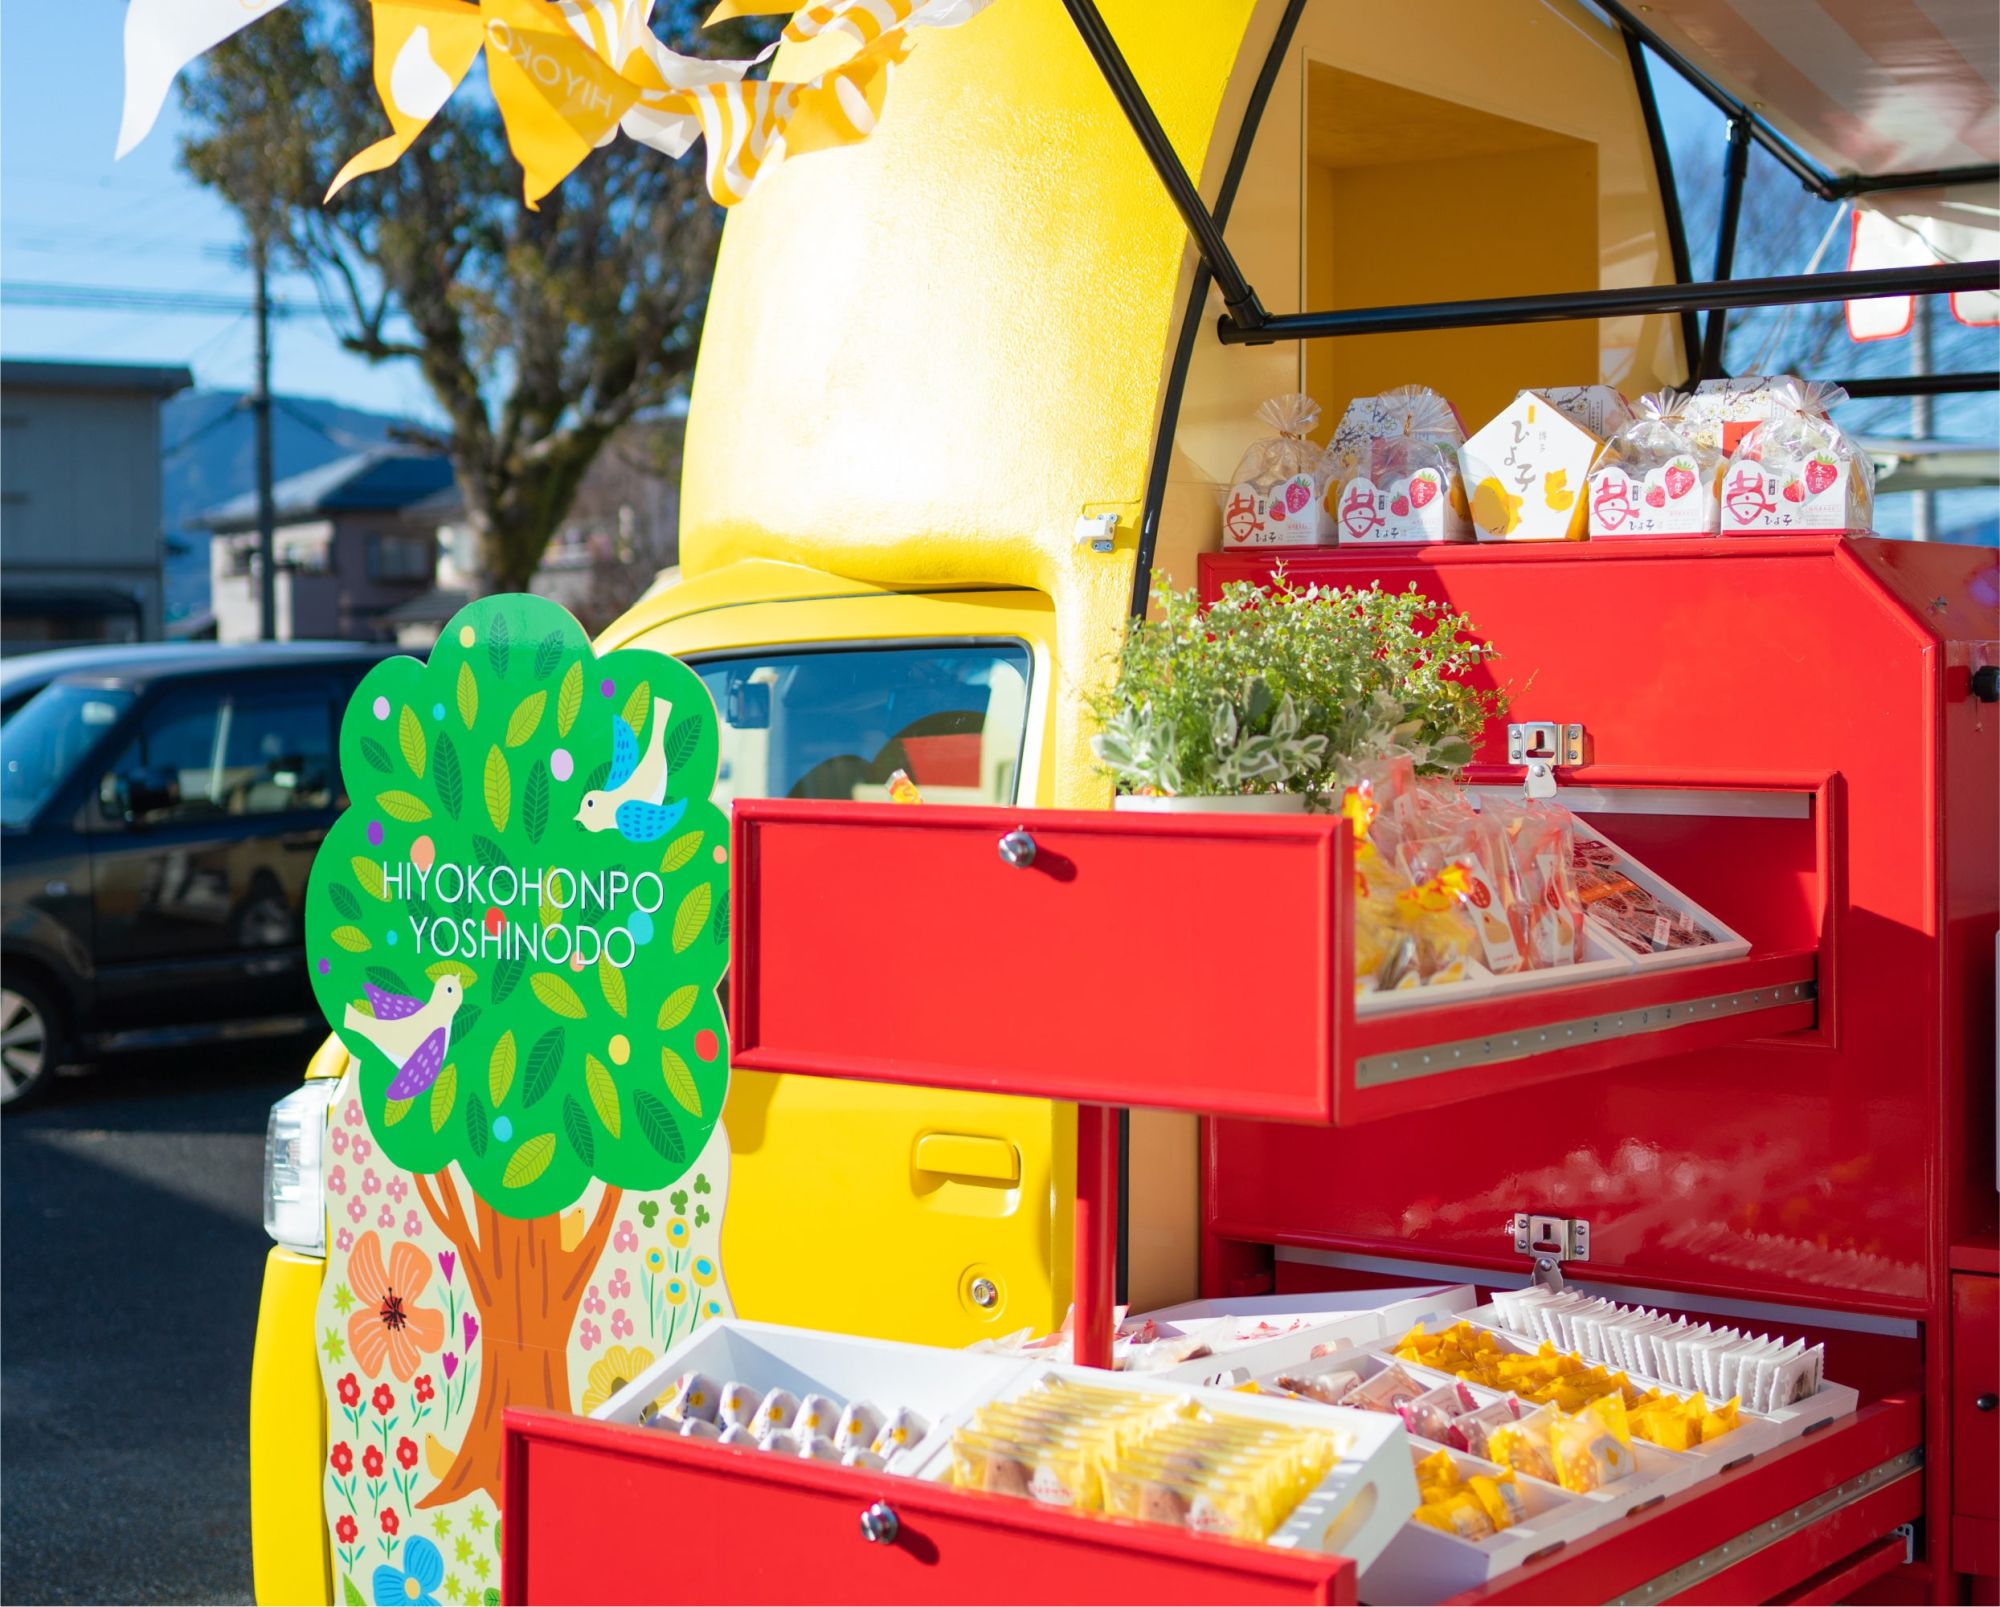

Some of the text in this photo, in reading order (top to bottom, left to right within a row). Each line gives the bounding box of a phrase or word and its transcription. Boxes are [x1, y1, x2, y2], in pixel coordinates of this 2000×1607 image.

[1503, 420, 1536, 493] ひよ子
[383, 861, 664, 914] HIYOKOHONPO
[409, 915, 636, 969] YOSHINODO
